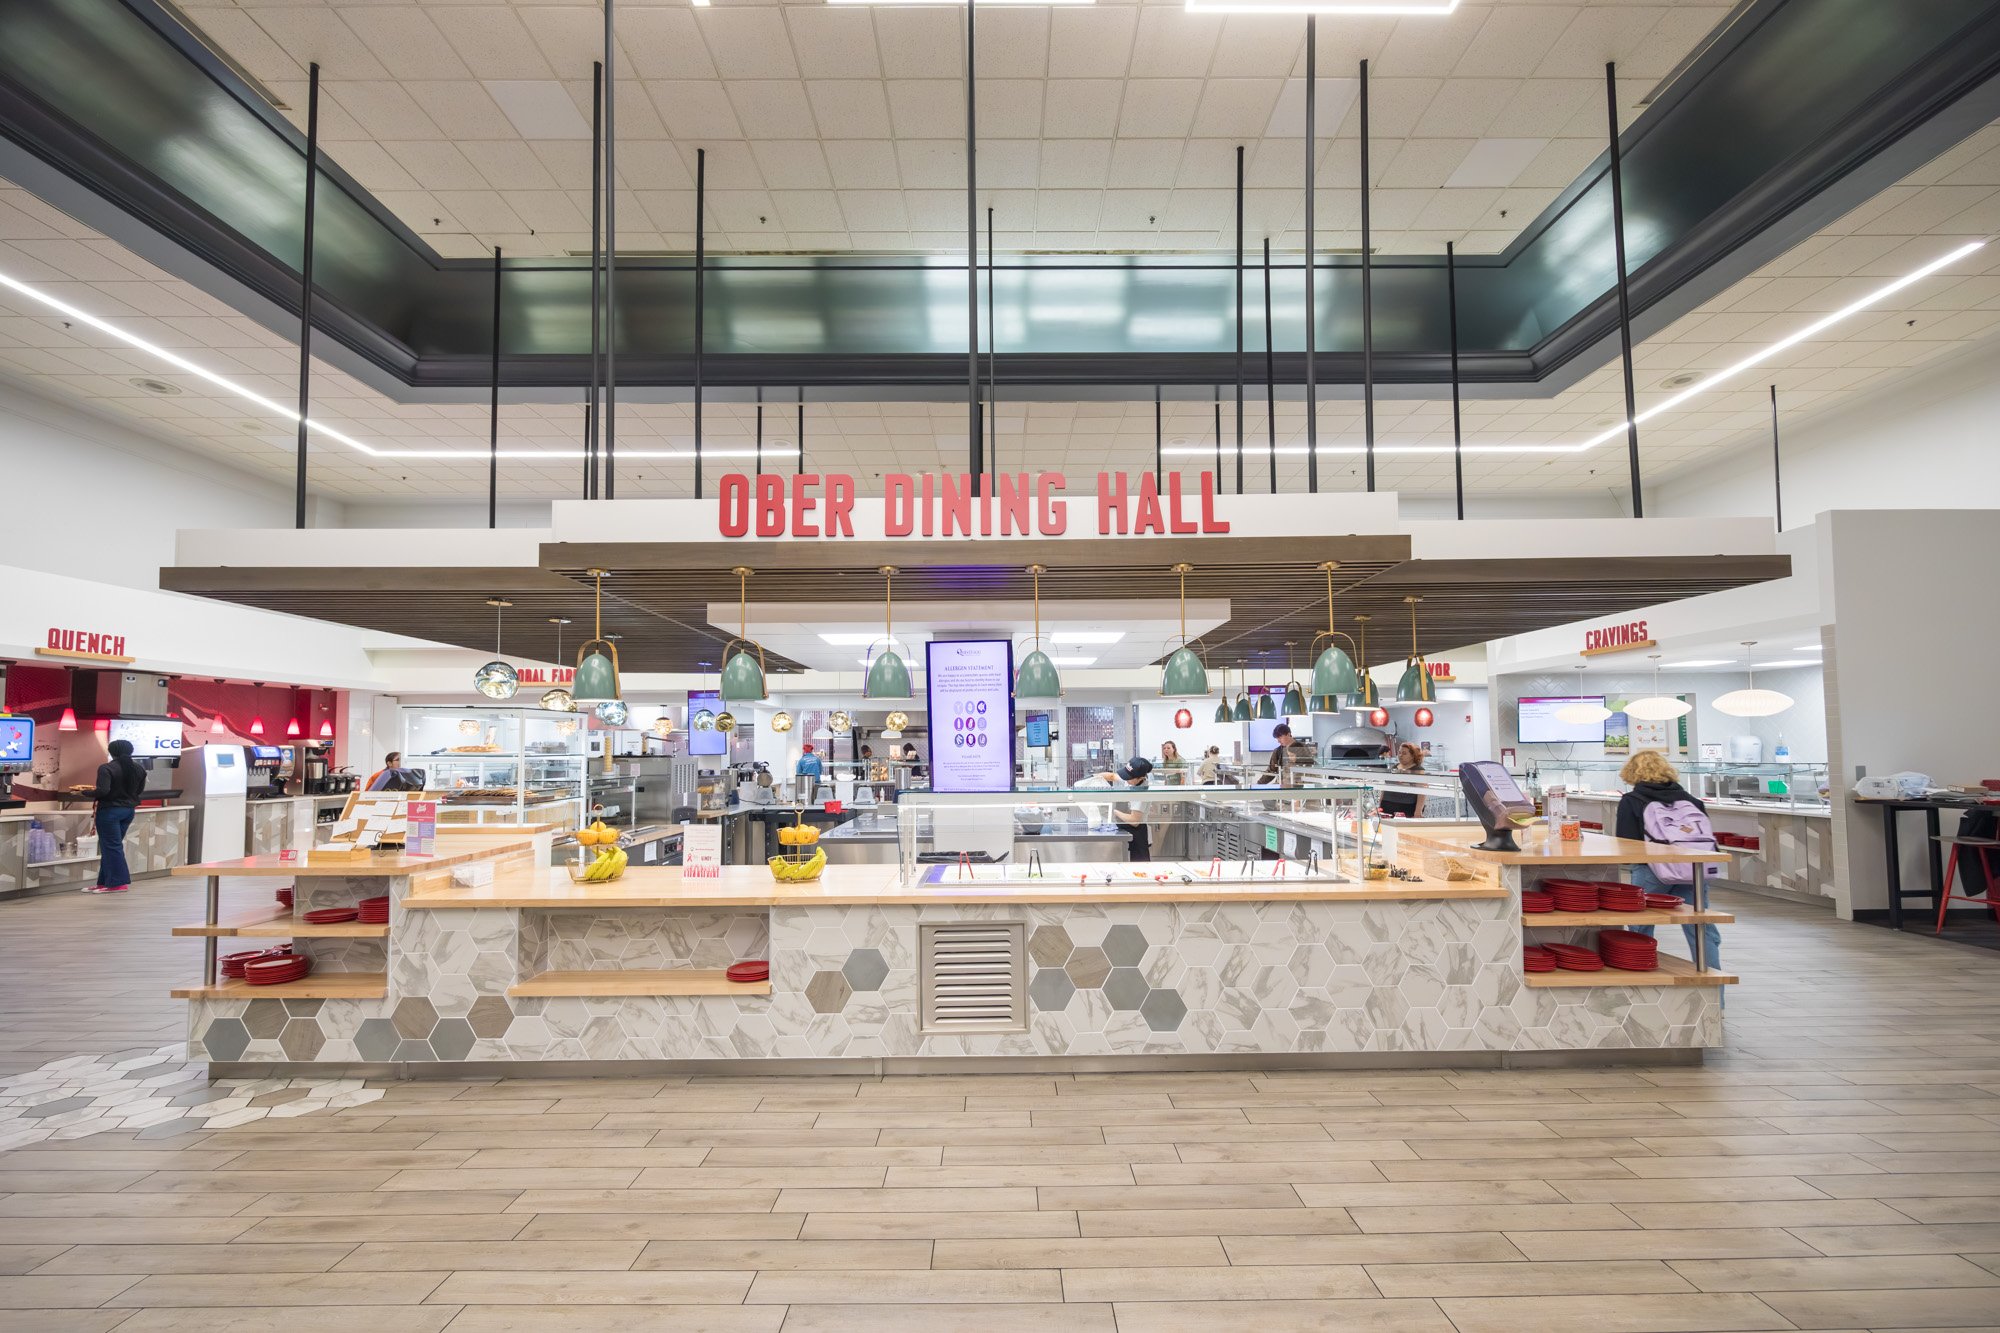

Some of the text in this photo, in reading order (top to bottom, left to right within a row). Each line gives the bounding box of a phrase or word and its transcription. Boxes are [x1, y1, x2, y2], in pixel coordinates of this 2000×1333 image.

[719, 470, 1231, 537] OBER DINING HALL
[47, 627, 125, 657] QUENCH
[1585, 620, 1649, 650] CRAVINGS
[1424, 662, 1451, 676] VOR
[154, 735, 181, 749] ice
